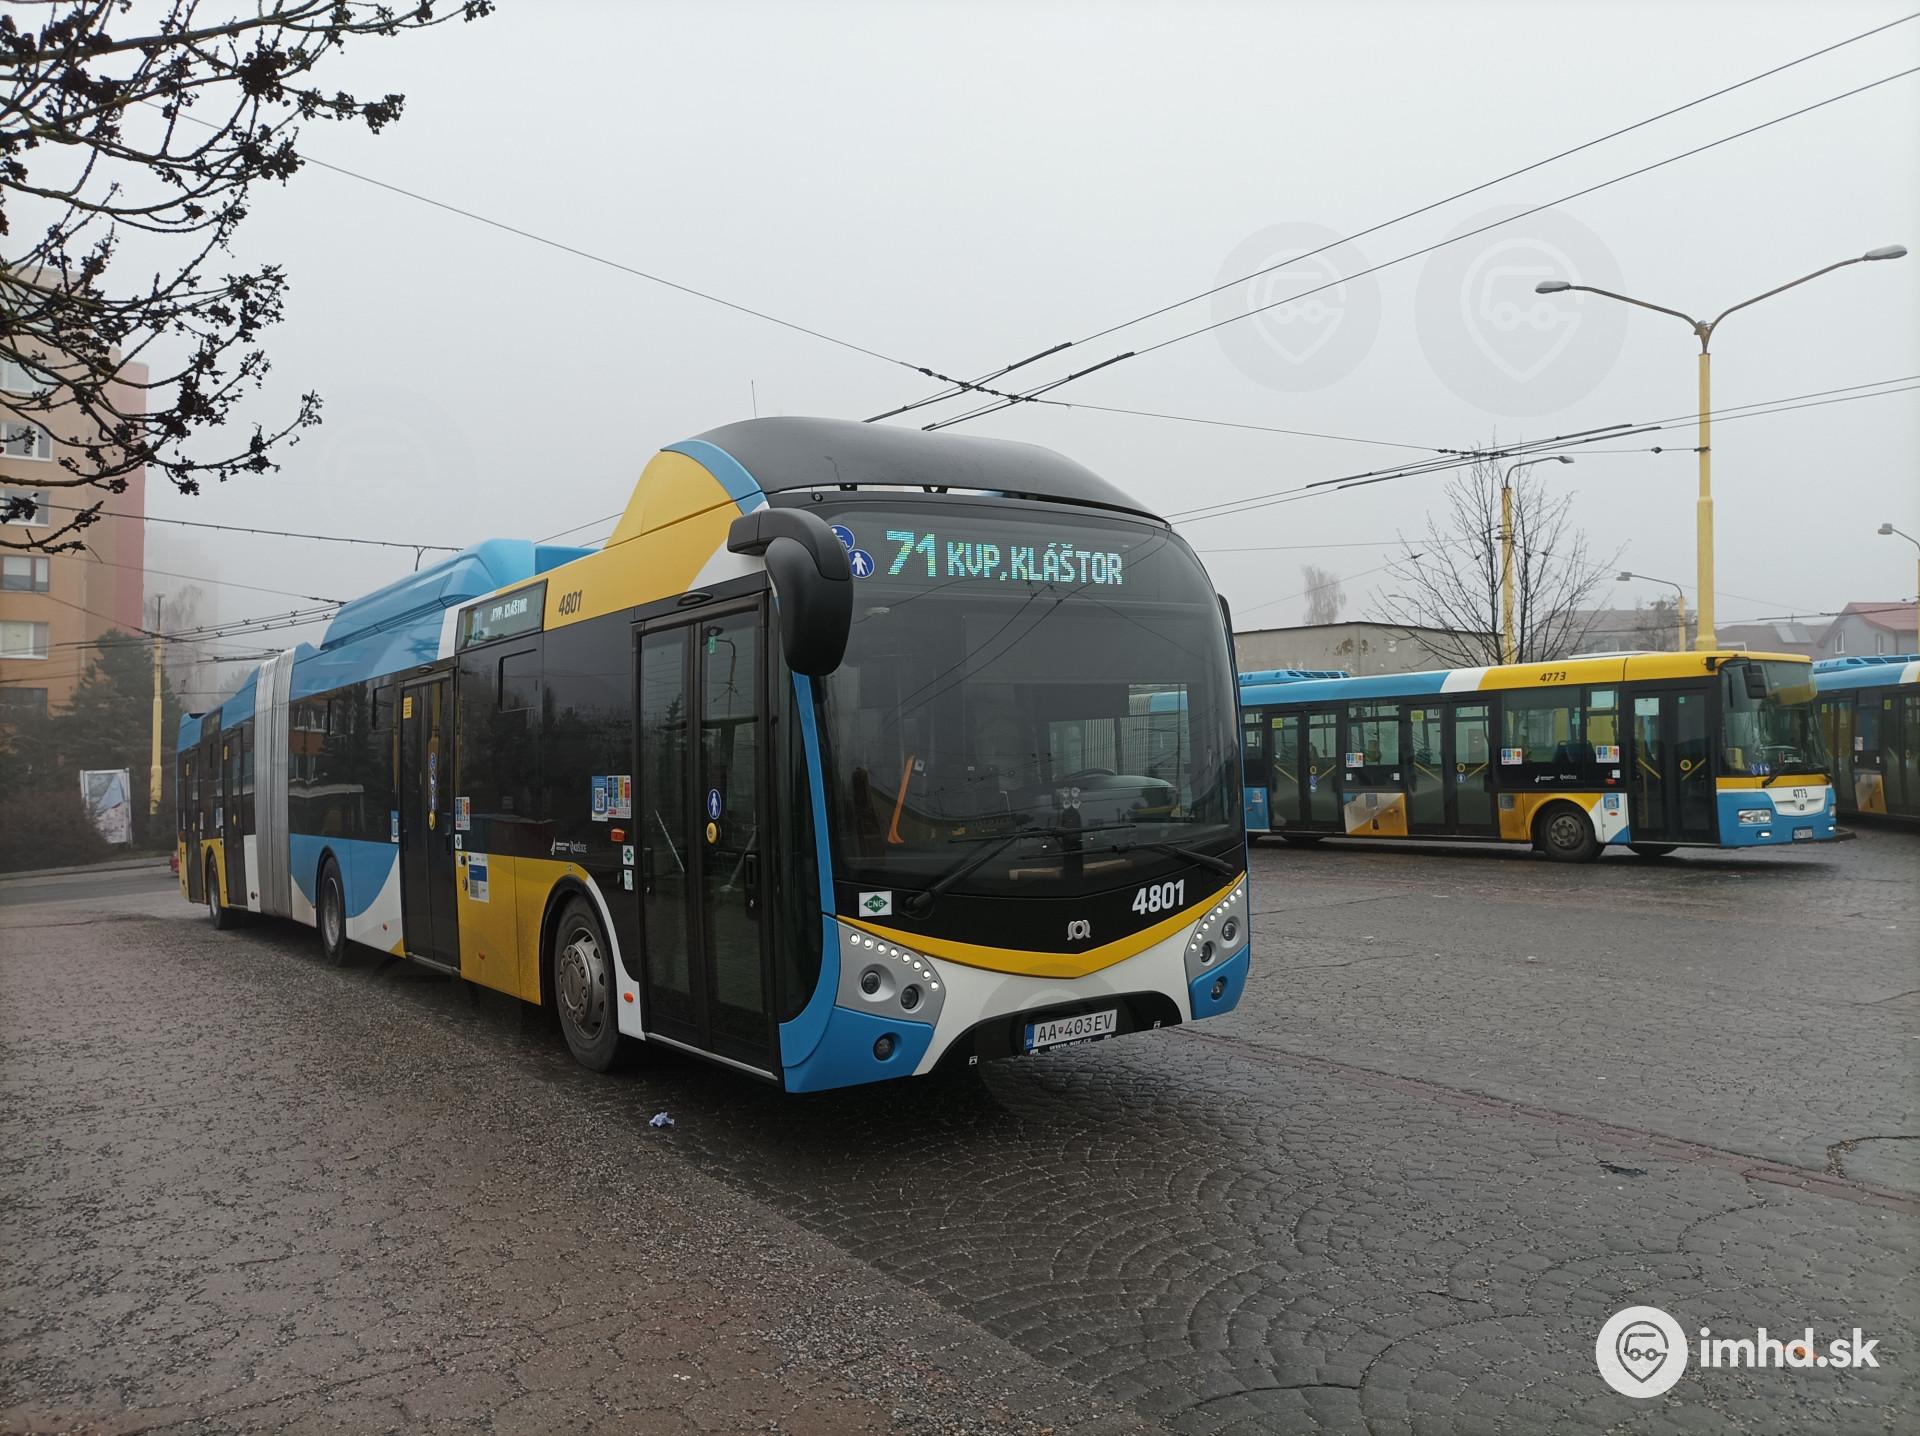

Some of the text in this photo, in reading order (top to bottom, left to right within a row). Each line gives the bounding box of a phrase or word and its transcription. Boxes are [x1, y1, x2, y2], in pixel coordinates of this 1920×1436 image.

[886, 530, 937, 577] 71
[1010, 542, 1123, 585] KLÁŠTOR
[558, 589, 583, 617] 4801
[1540, 671, 1567, 682] 4773
[1792, 788, 1808, 799] 4773
[867, 900, 885, 909] CNG
[1131, 878, 1185, 915] 4801
